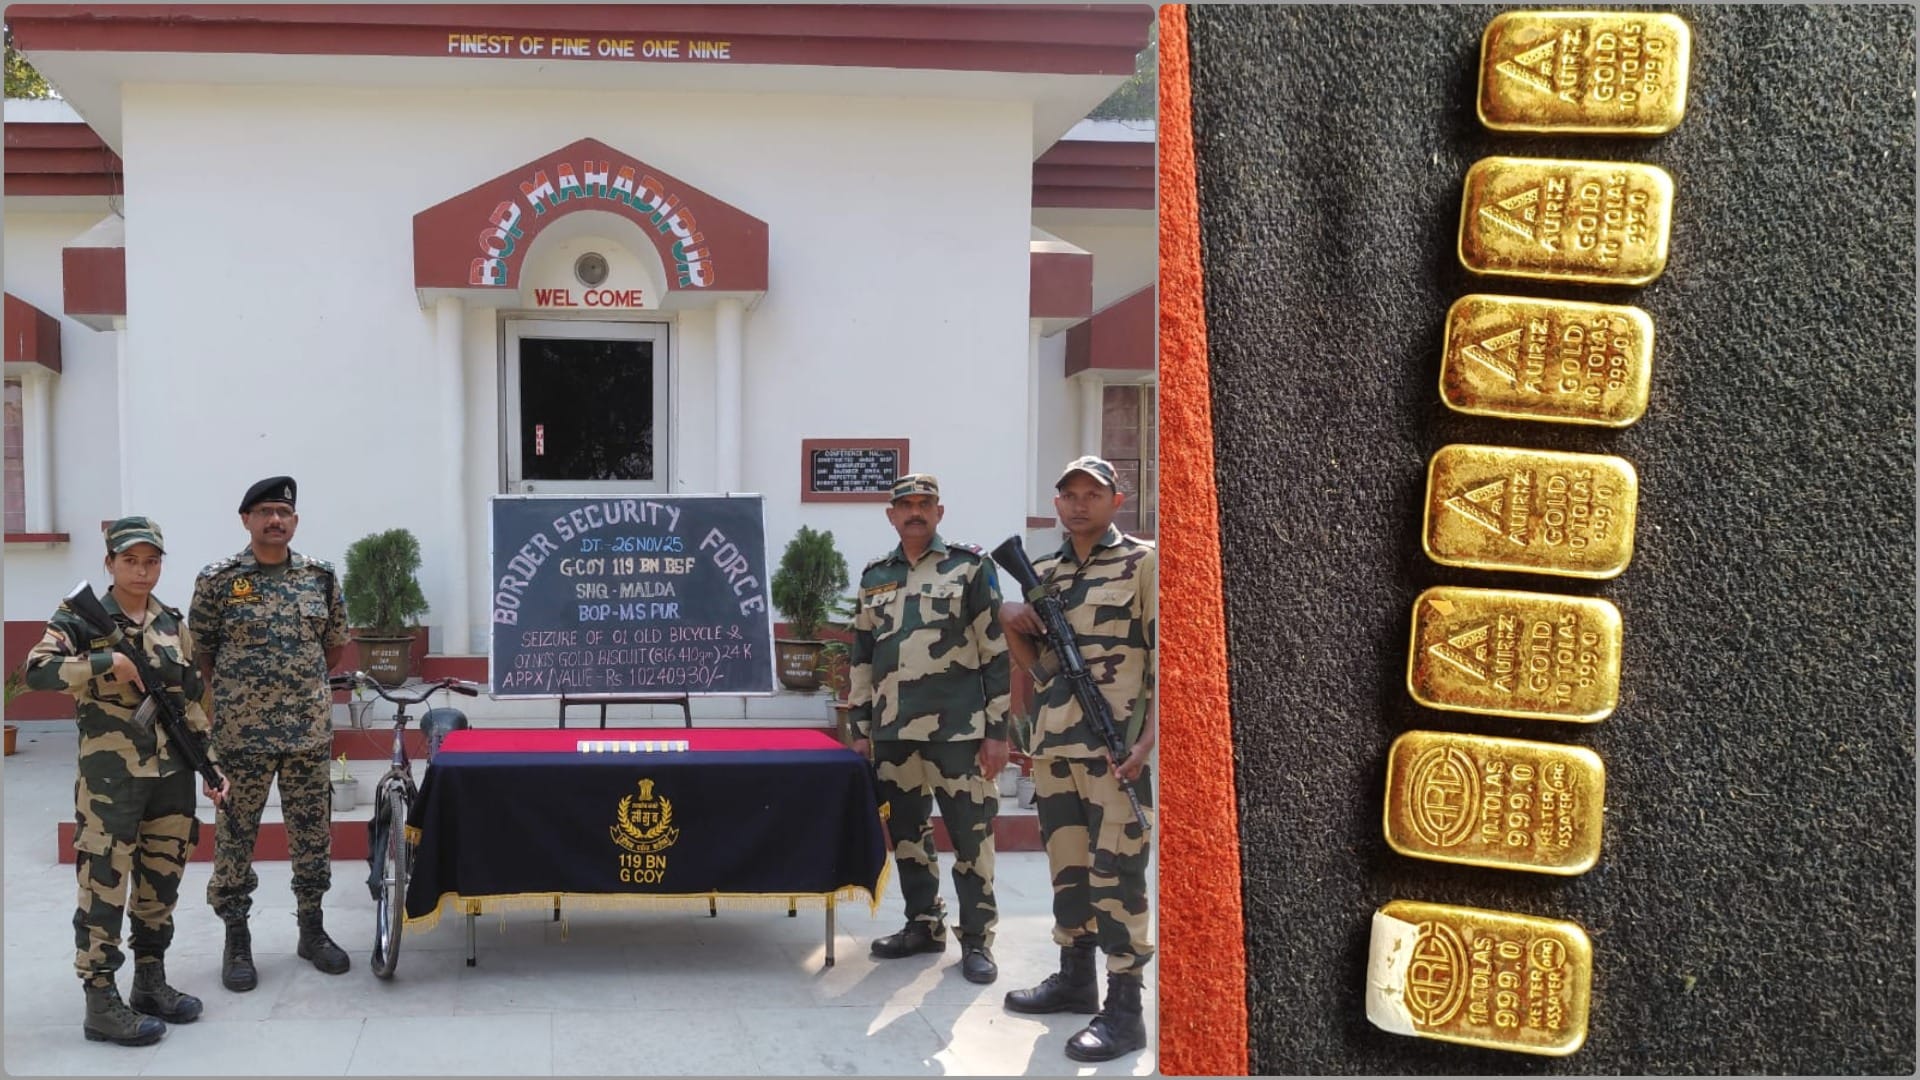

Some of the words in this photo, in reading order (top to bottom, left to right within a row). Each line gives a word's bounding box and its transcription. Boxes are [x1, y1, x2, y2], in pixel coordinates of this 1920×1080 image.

[448, 33, 514, 55] FINEST
[519, 36, 545, 56] OF
[551, 37, 591, 57] FINE
[598, 39, 634, 58] ONE
[642, 40, 680, 59] ONE
[688, 41, 731, 60] NINE
[1594, 33, 1618, 101] GOLD
[1621, 24, 1642, 86] TOLAS
[1620, 91, 1637, 111] 10
[469, 200, 526, 287] BOP
[519, 160, 715, 288] MAHADIPUR
[1576, 182, 1602, 251] GOLD
[1602, 173, 1626, 236] TOLAS
[1600, 240, 1619, 262] 10
[535, 289, 578, 308] WEL
[584, 289, 643, 308] COME
[1558, 325, 1584, 394] GOLD
[1588, 317, 1610, 379] TOLAS
[1583, 386, 1600, 405] 10
[1544, 475, 1568, 546] GOLD
[1572, 469, 1592, 529] TOLAS
[494, 532, 559, 626] BORDER
[552, 500, 681, 543] SECURITY
[699, 527, 766, 617] FORCE
[612, 557, 634, 576] 119
[639, 557, 660, 574] BN
[664, 556, 695, 575] BSF
[1569, 538, 1588, 564] 10
[619, 581, 676, 598] MALDA
[650, 602, 681, 619] PUR
[521, 630, 577, 648] SEIZURE
[585, 630, 604, 645] OF
[634, 628, 662, 644] OLD
[670, 625, 723, 643] BICYCLE
[1529, 621, 1553, 692] GOLD
[1557, 612, 1576, 675] TOLAS
[559, 650, 594, 667] GOLD
[1556, 683, 1572, 706] 10
[1507, 763, 1535, 848] 999.0
[619, 854, 642, 868] 119
[646, 855, 666, 869] BN
[619, 869, 630, 882] G
[634, 870, 664, 884] COY
[1496, 940, 1523, 1028] 999.0
